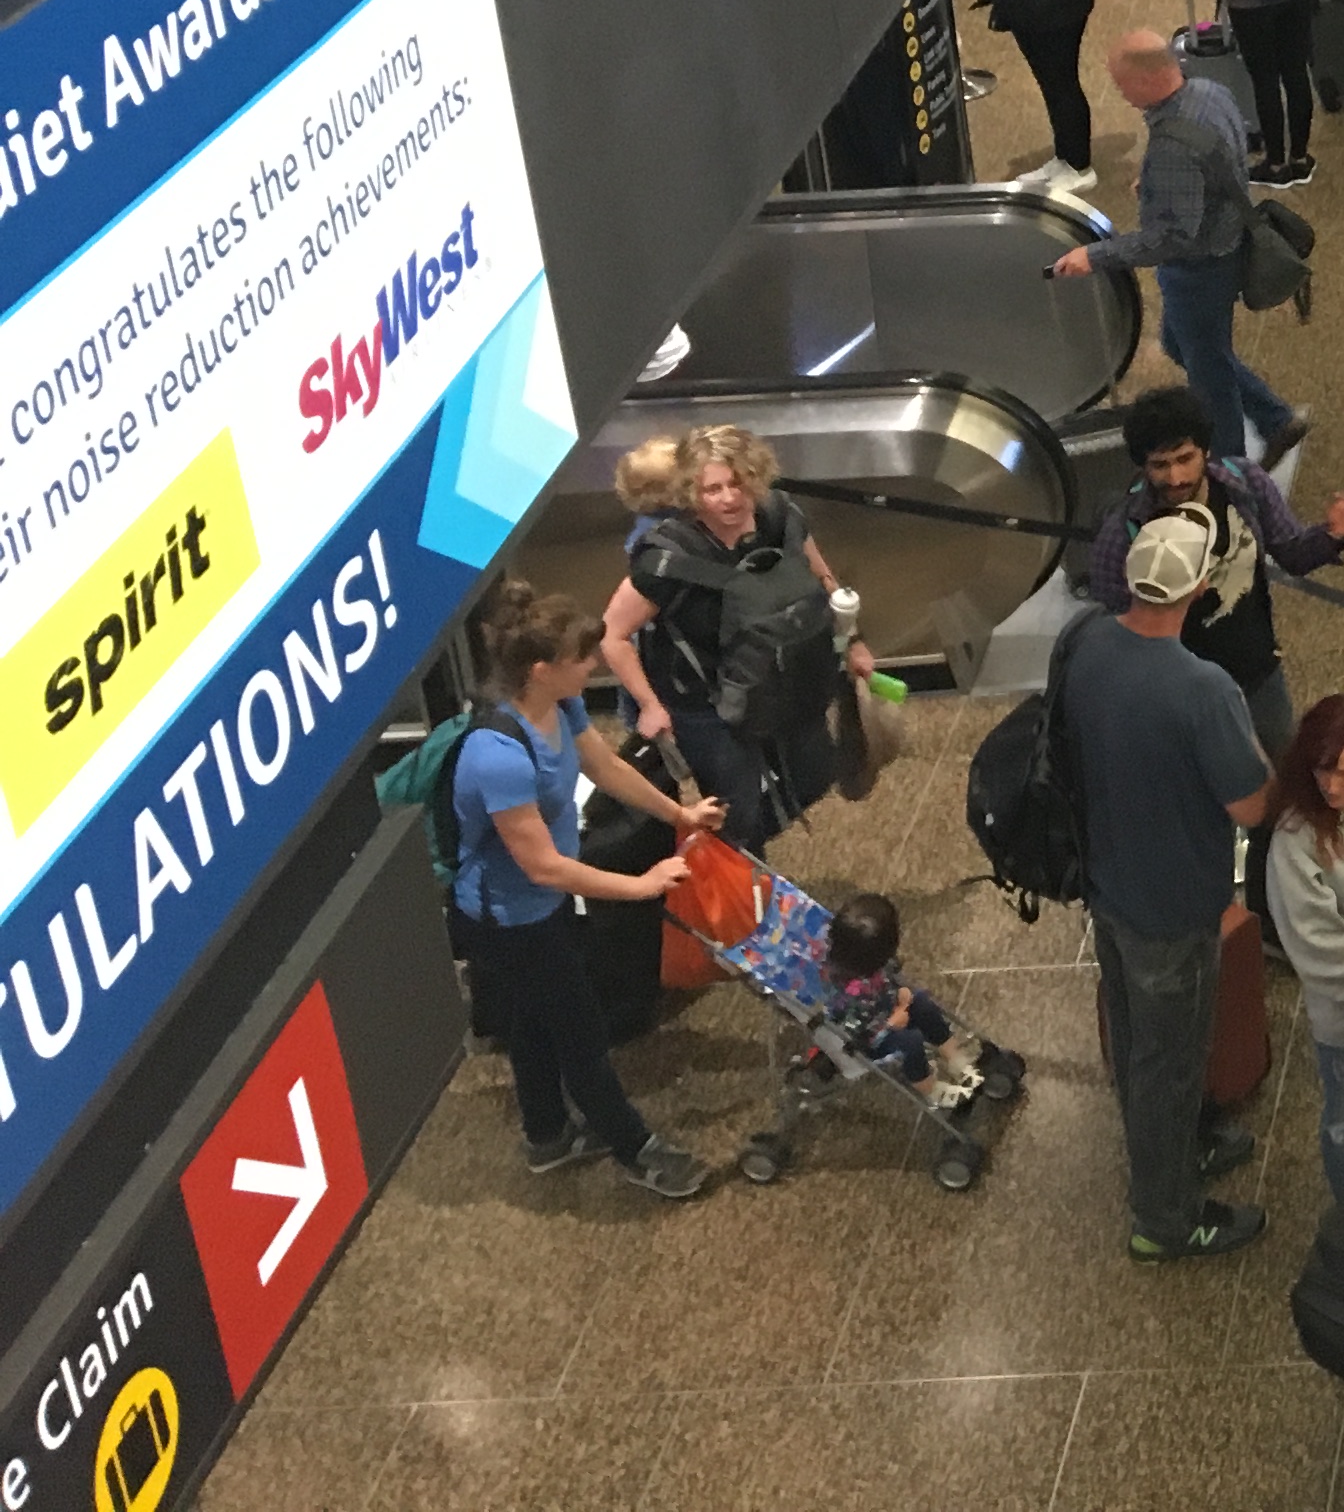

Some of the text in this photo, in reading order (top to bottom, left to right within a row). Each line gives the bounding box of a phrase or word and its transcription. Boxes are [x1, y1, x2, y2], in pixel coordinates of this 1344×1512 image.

[11, 201, 248, 445] congratulates
[249, 152, 301, 221] the
[302, 34, 424, 171] following
[43, 410, 140, 529] noise
[145, 257, 296, 428] reduction
[299, 76, 473, 275] achievements:
[299, 200, 479, 454] SkyWest
[45, 505, 211, 736] spirit
[36, 1272, 154, 1450] Claim
